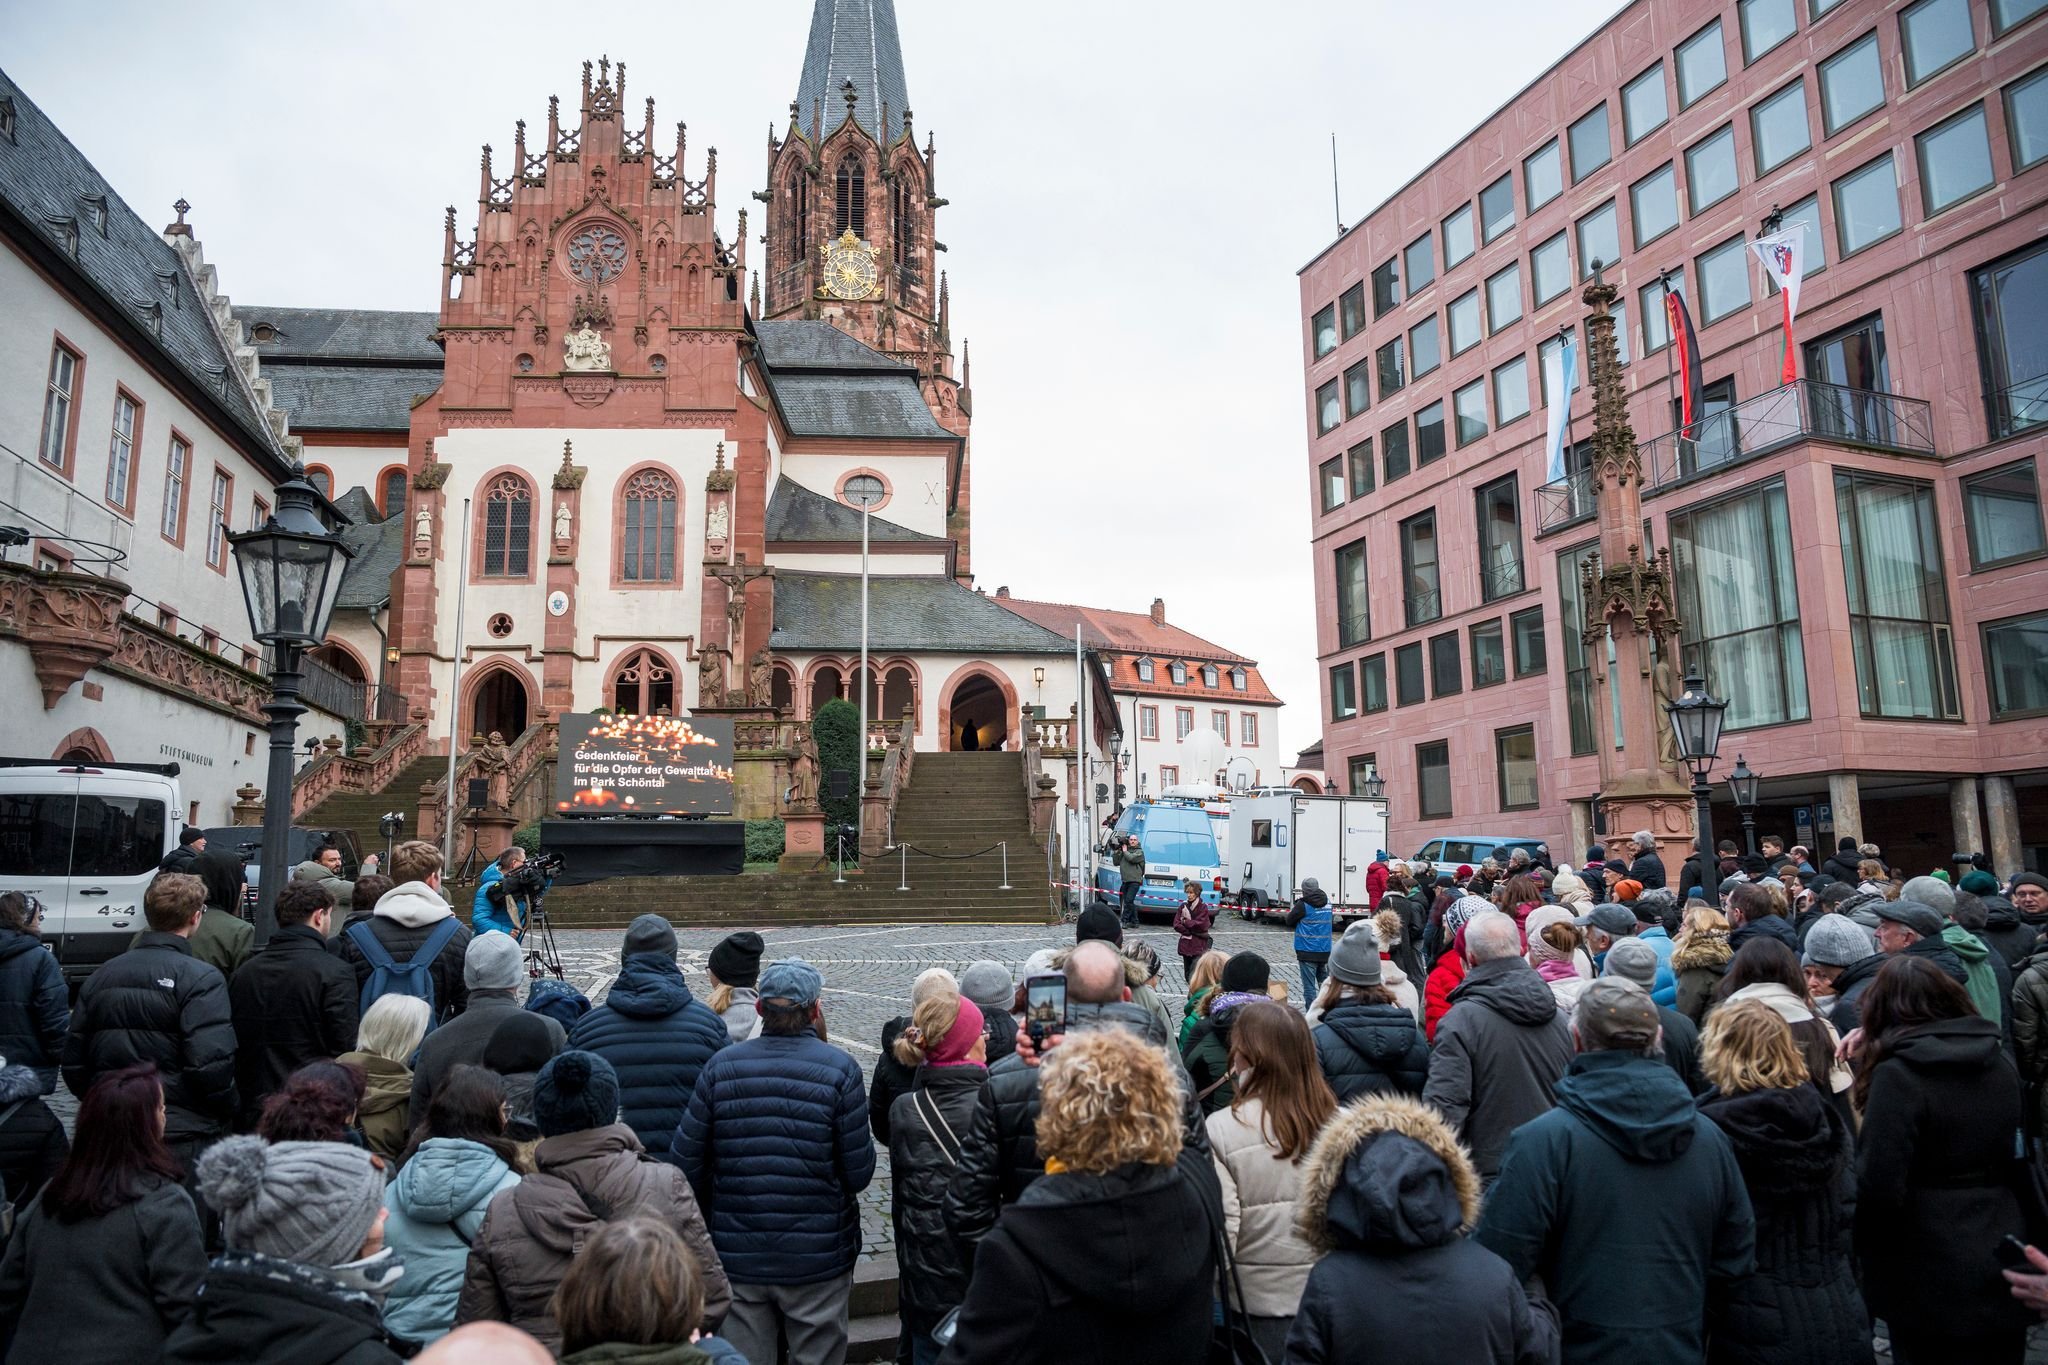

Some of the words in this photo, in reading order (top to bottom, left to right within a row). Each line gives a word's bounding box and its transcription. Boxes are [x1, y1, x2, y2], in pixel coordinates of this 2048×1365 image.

[160, 743, 213, 767] STIFTSMUSEUM
[575, 750, 641, 761] Gedenkfeier
[574, 763, 591, 773] für
[593, 763, 609, 774] die
[612, 764, 642, 776] Opfer
[644, 765, 662, 775] der
[665, 765, 714, 776] Gewalttat
[574, 776, 588, 787] im
[590, 776, 615, 787] Park
[617, 777, 665, 788] Schöntal
[1798, 810, 1807, 824] P
[1820, 806, 1829, 821] P
[1200, 869, 1211, 880] BR
